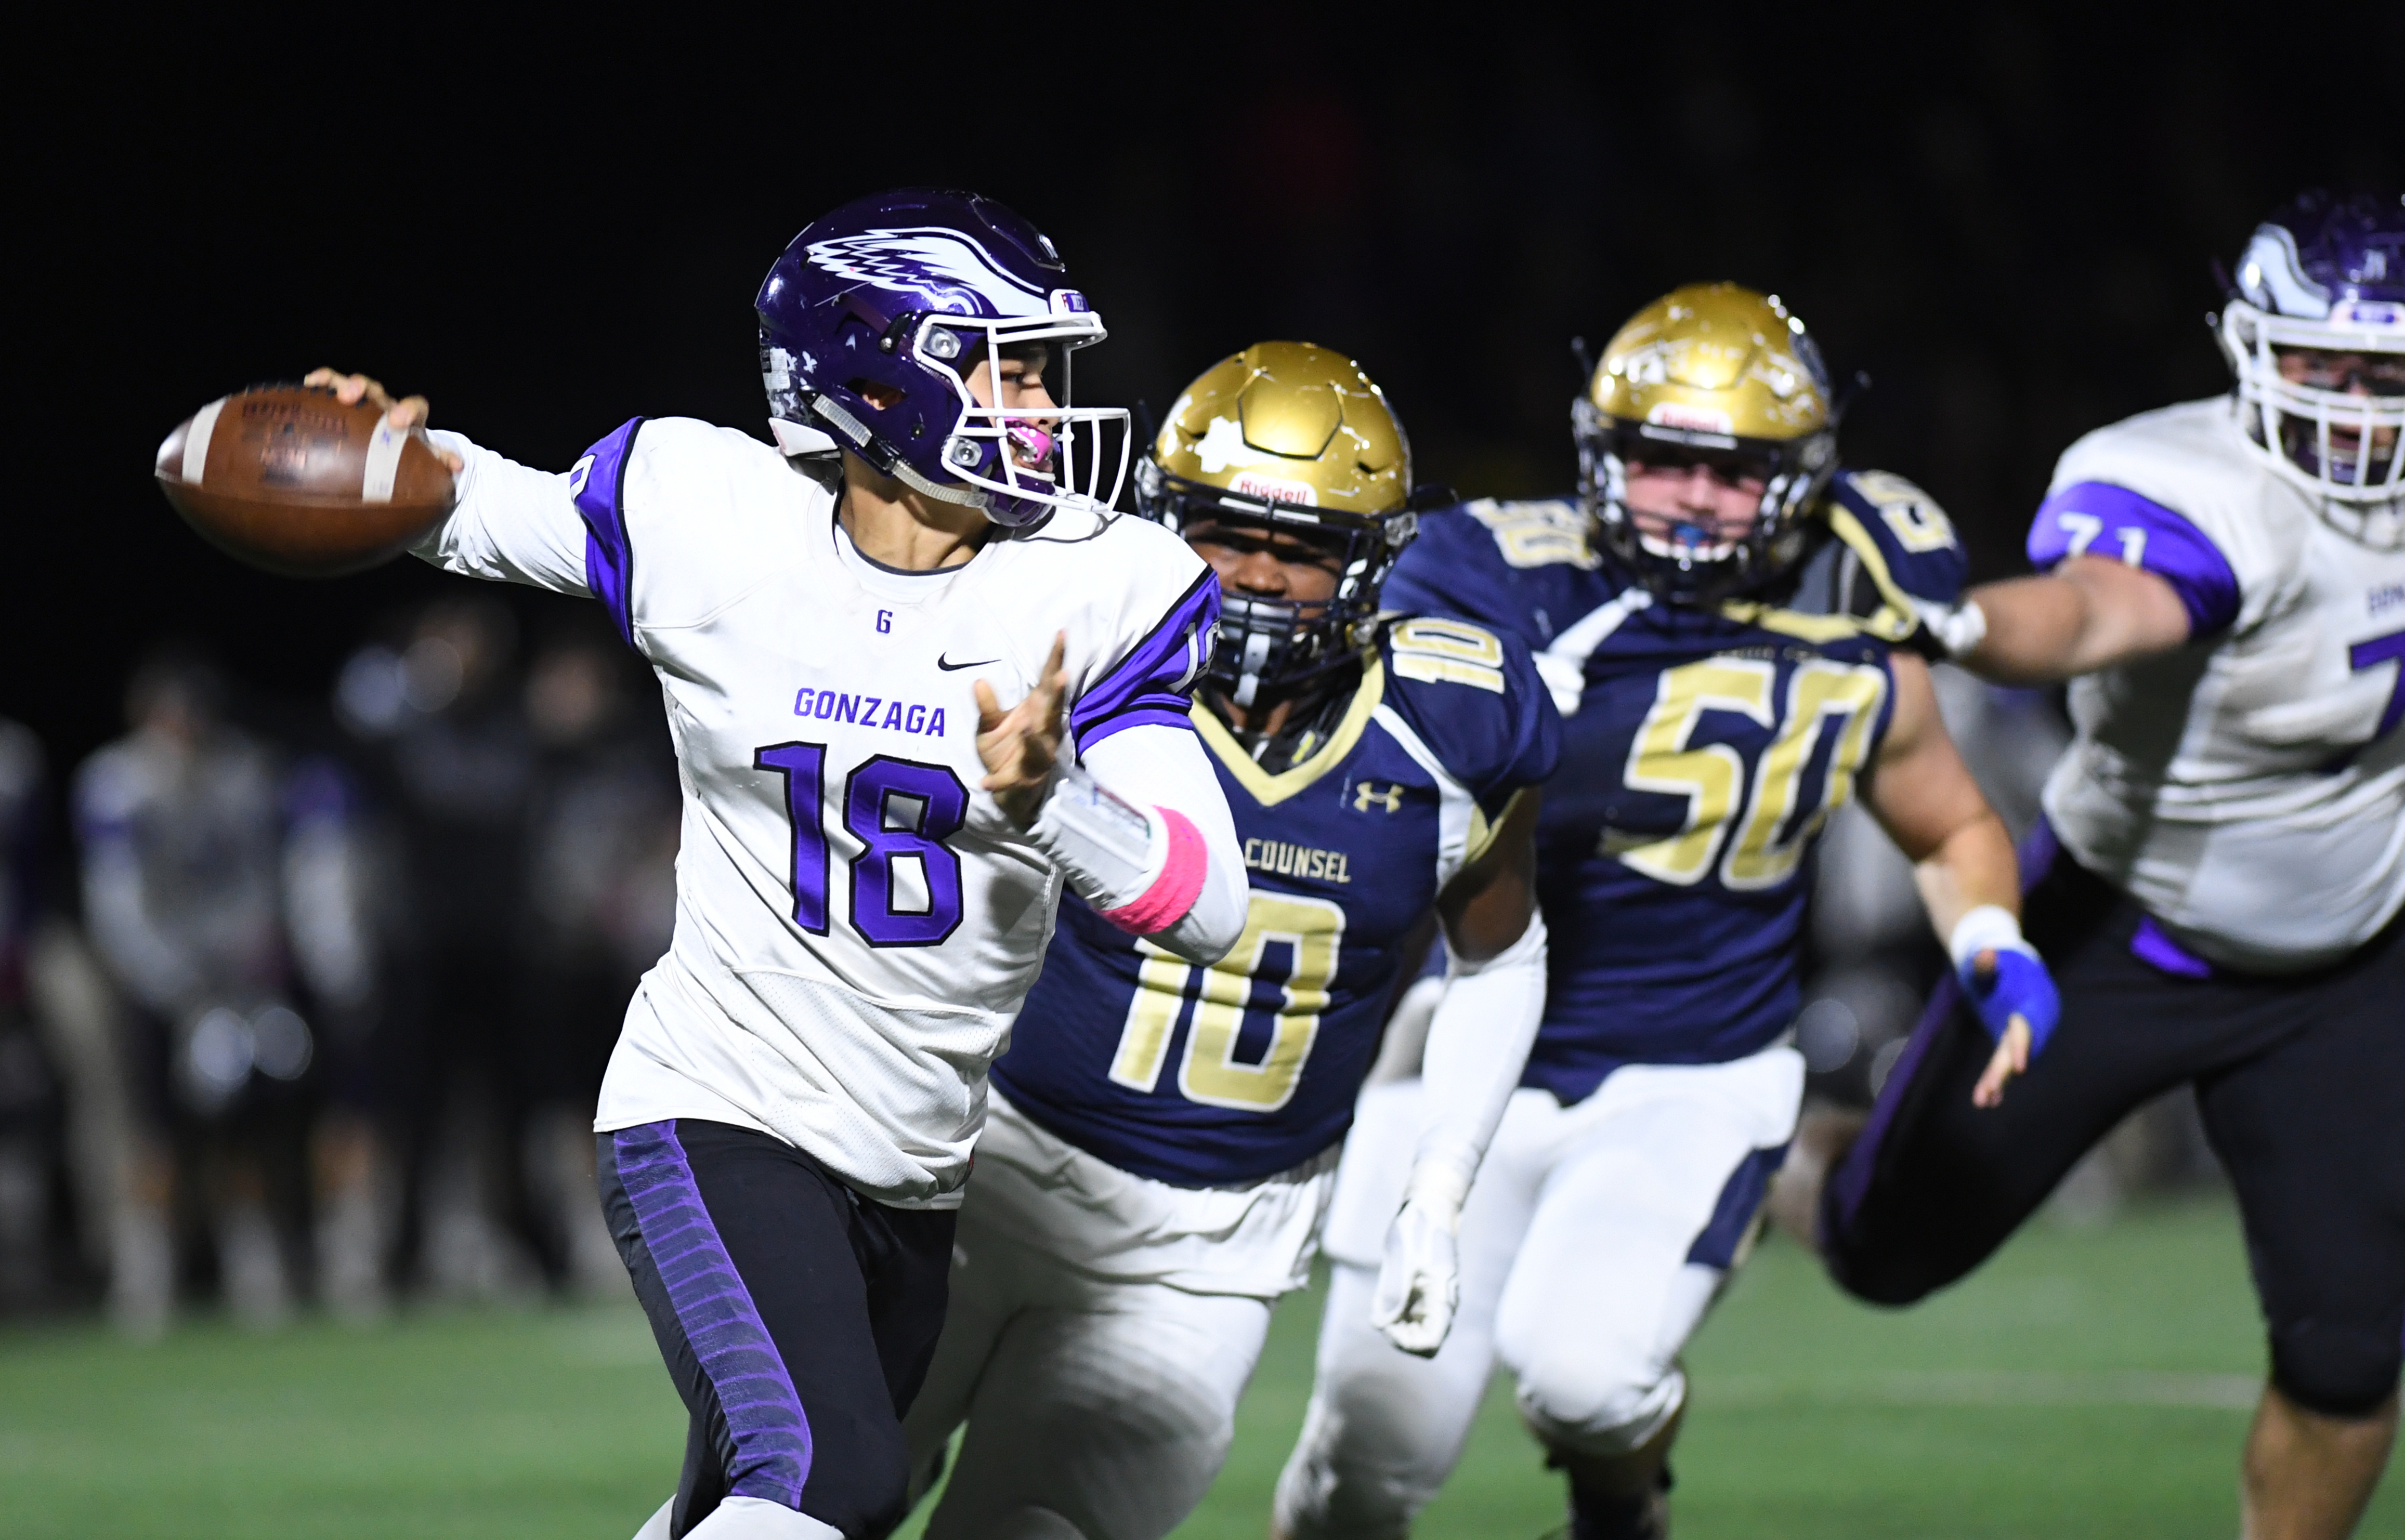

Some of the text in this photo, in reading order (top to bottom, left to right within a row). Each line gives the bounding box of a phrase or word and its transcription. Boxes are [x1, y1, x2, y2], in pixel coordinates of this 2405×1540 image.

[1240, 480, 1307, 505] Riddell
[2057, 511, 2148, 569] 71
[875, 609, 893, 635] G
[1390, 617, 1505, 695] 10
[793, 687, 946, 738] GONZAGA
[1600, 657, 1888, 893] 50
[753, 740, 970, 949] 18
[1244, 837, 1351, 884] COUNSEL
[1106, 888, 1347, 1114] 10
